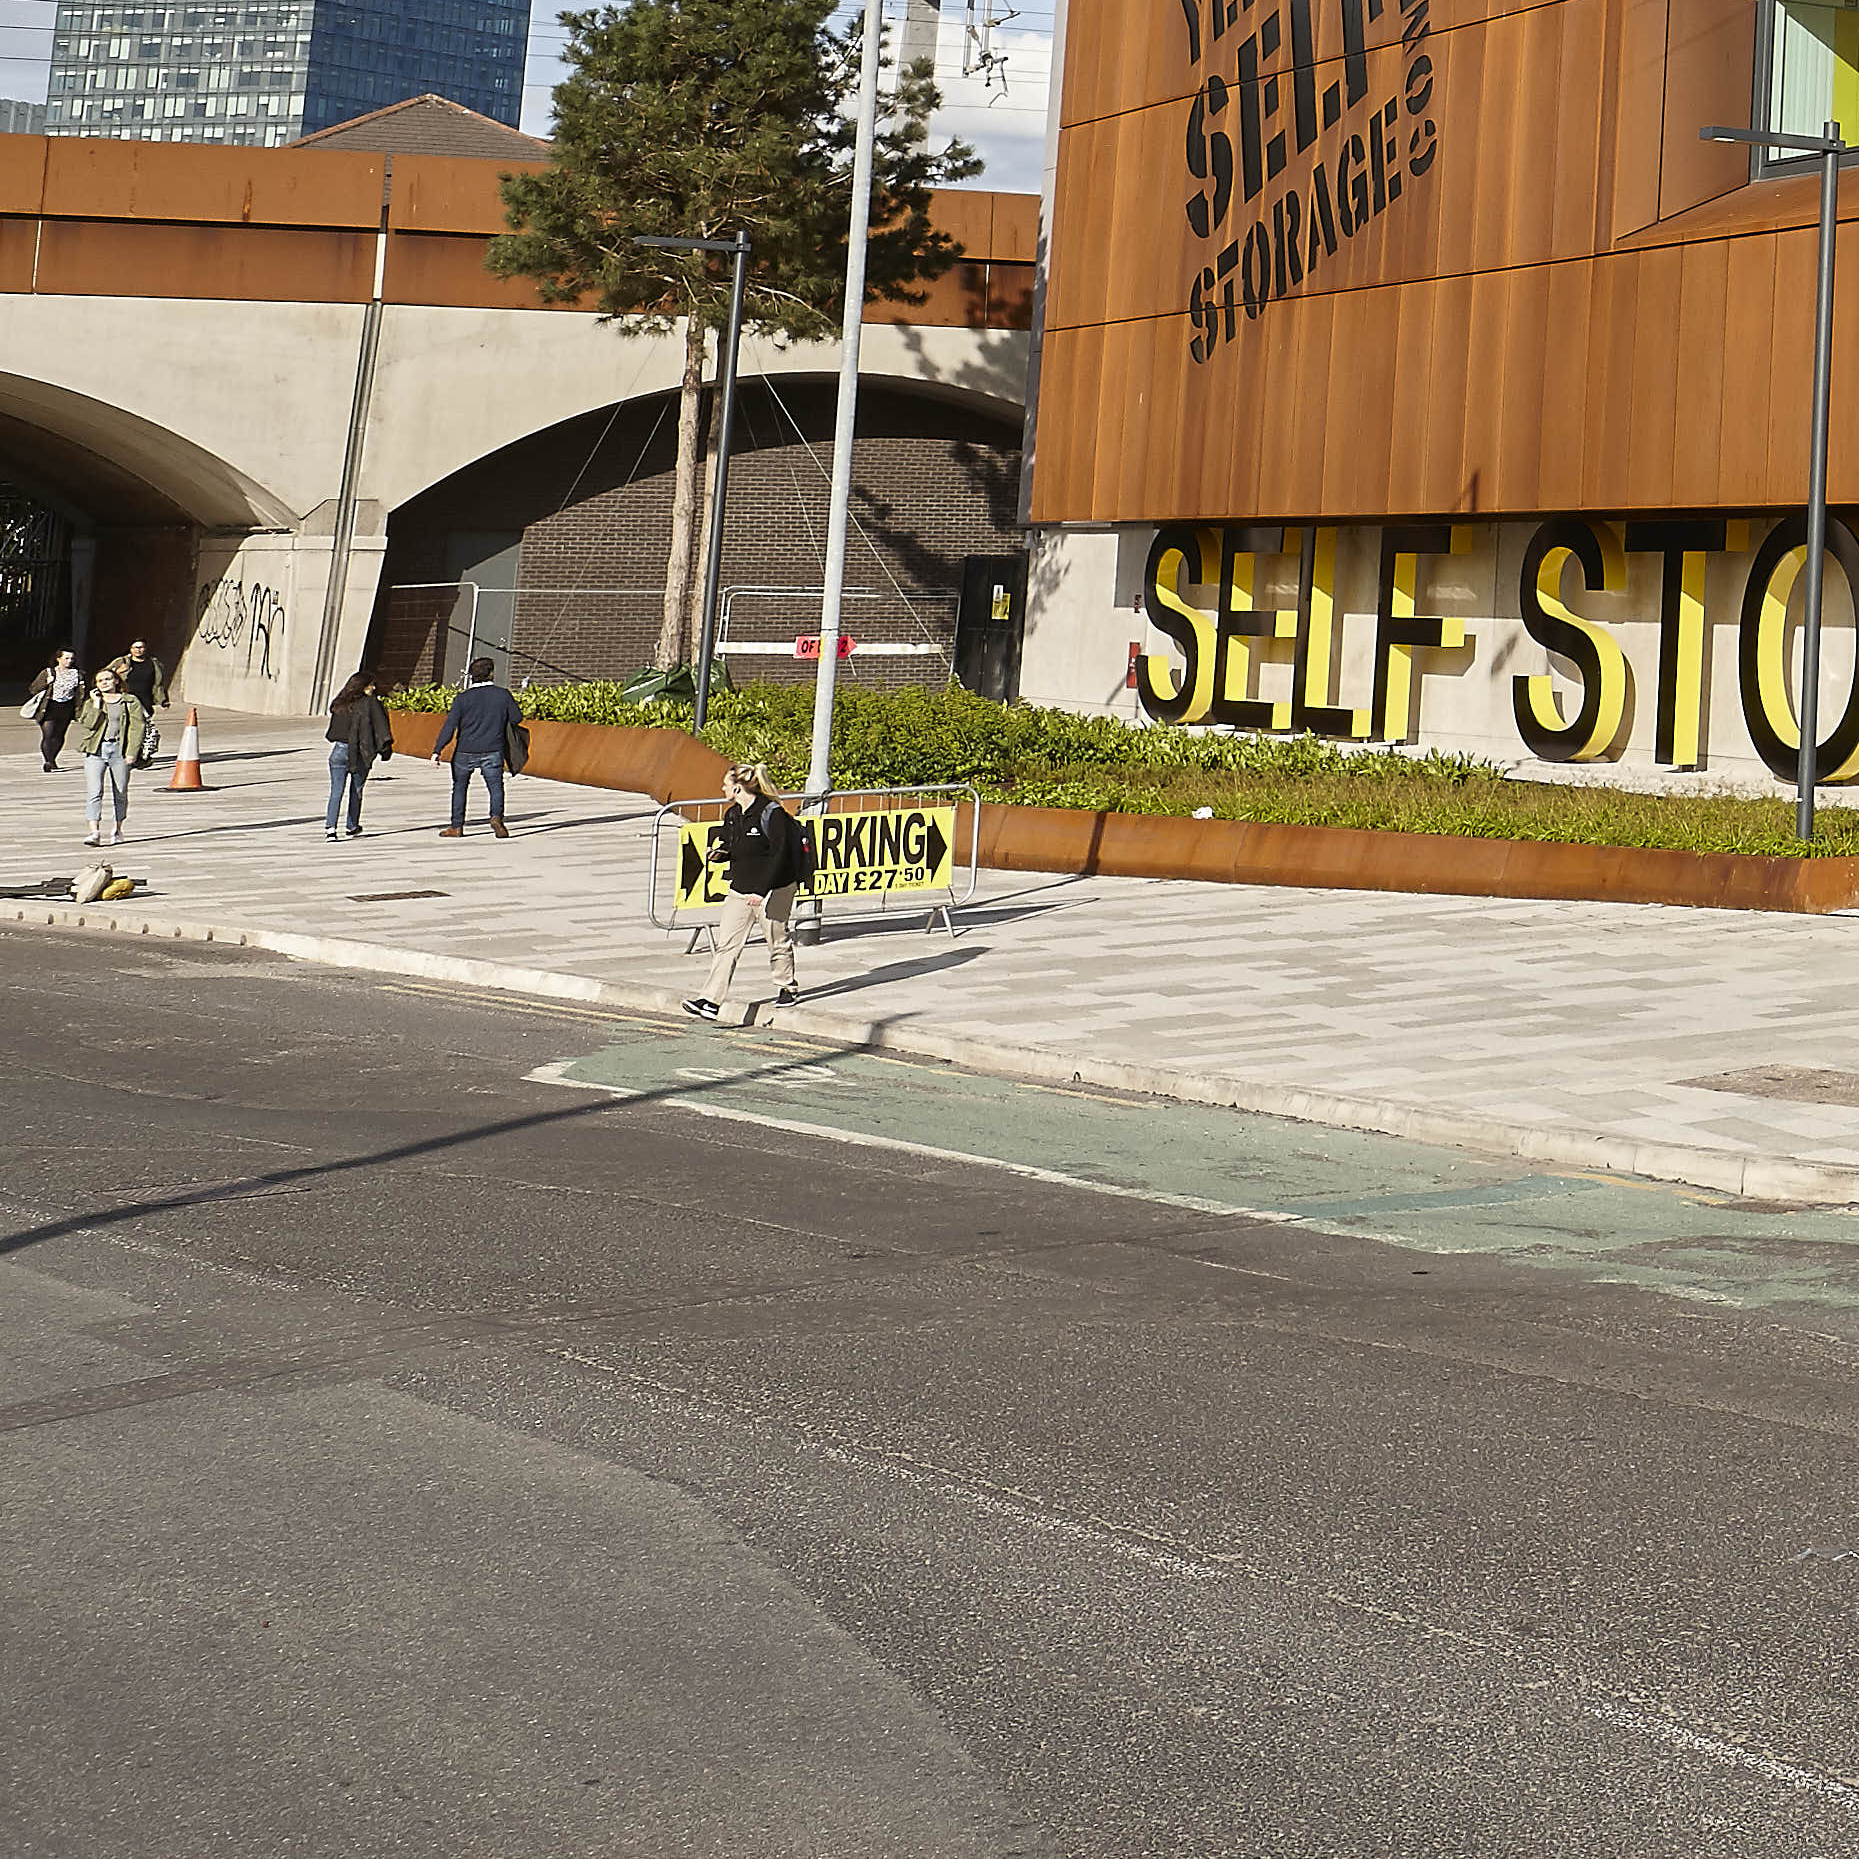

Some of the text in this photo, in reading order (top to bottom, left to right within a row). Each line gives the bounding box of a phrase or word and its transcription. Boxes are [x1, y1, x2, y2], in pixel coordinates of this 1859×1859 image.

[1187, 94, 1402, 365] STORAGE
[1136, 522, 1474, 743] SELF
[799, 812, 926, 870] RKING
[814, 873, 848, 894] DAY
